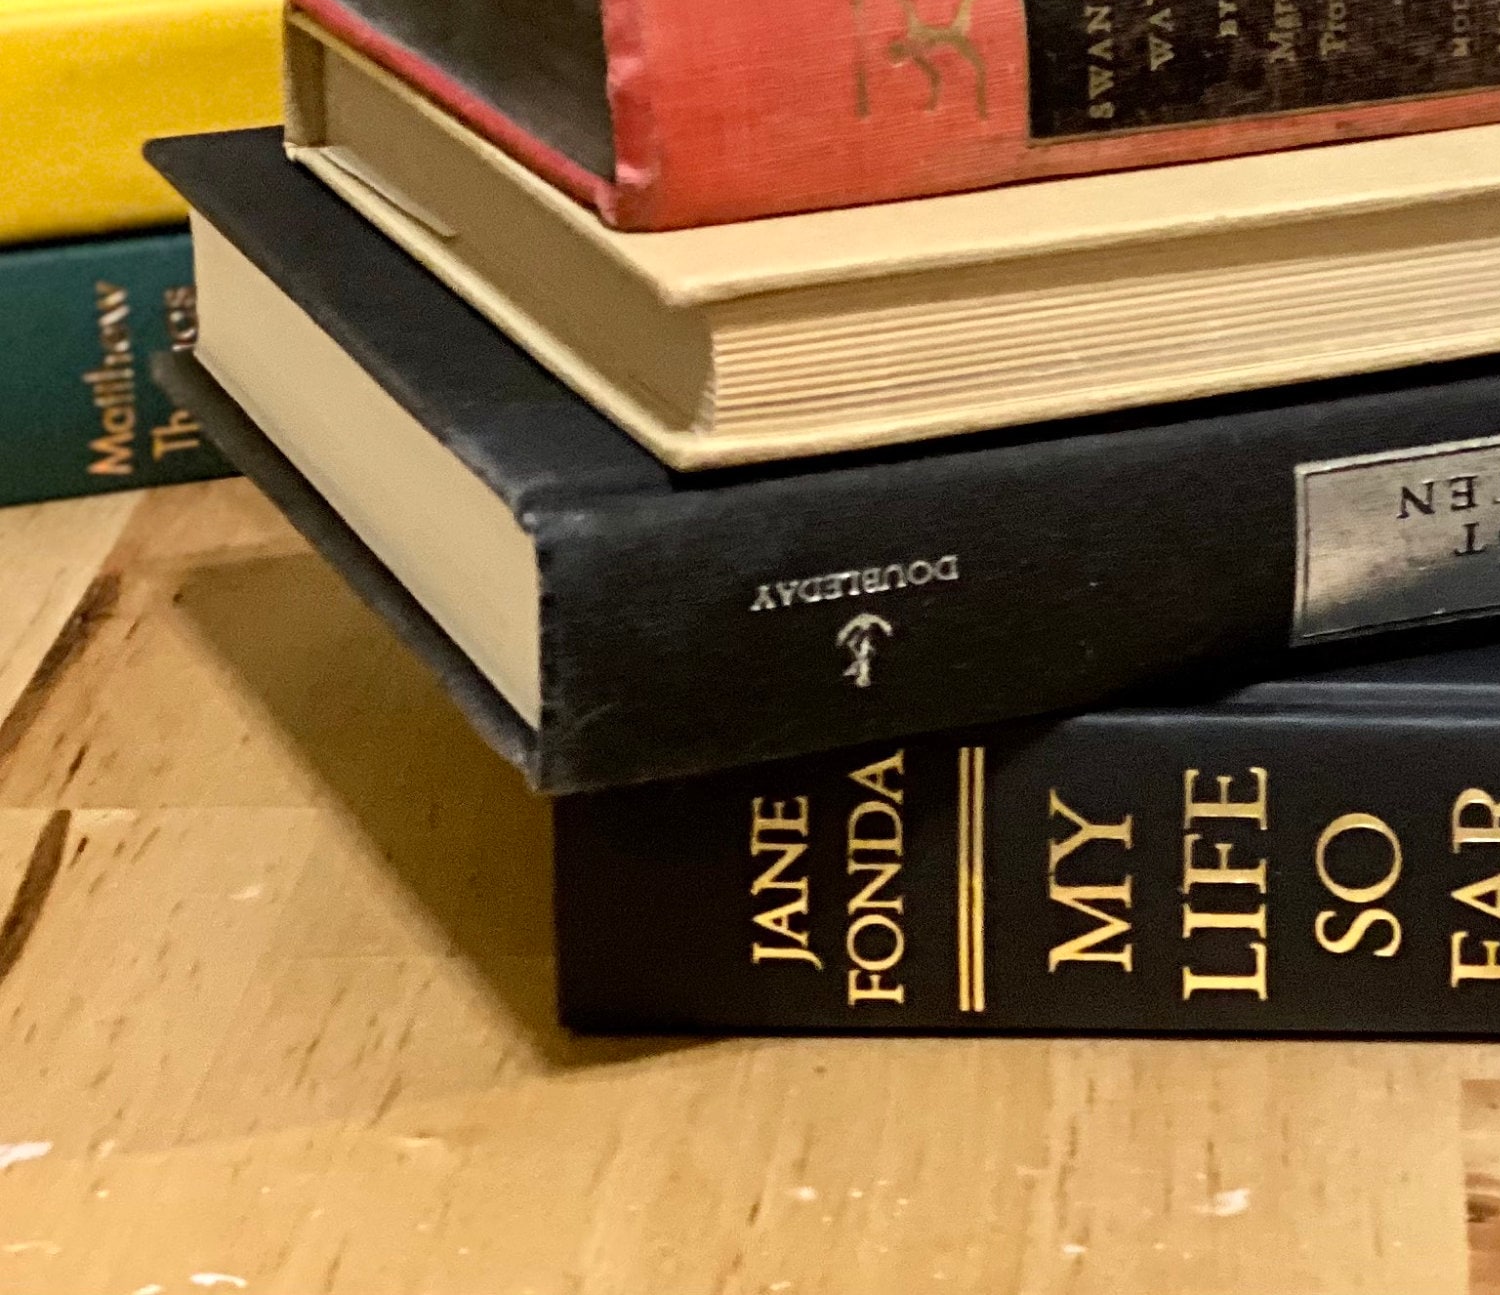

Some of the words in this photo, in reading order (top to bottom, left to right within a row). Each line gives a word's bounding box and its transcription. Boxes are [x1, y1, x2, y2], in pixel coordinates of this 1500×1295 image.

[1218, 0, 1239, 38] BY
[82, 280, 134, 476] Matthew
[152, 410, 199, 462] Th
[749, 554, 959, 611] DOUBLEDAY
[751, 794, 823, 970] JANE
[846, 749, 905, 1005] FONDA
[1048, 789, 1133, 974] MY
[1182, 766, 1268, 1002] LIFE
[1314, 812, 1402, 957] SO
